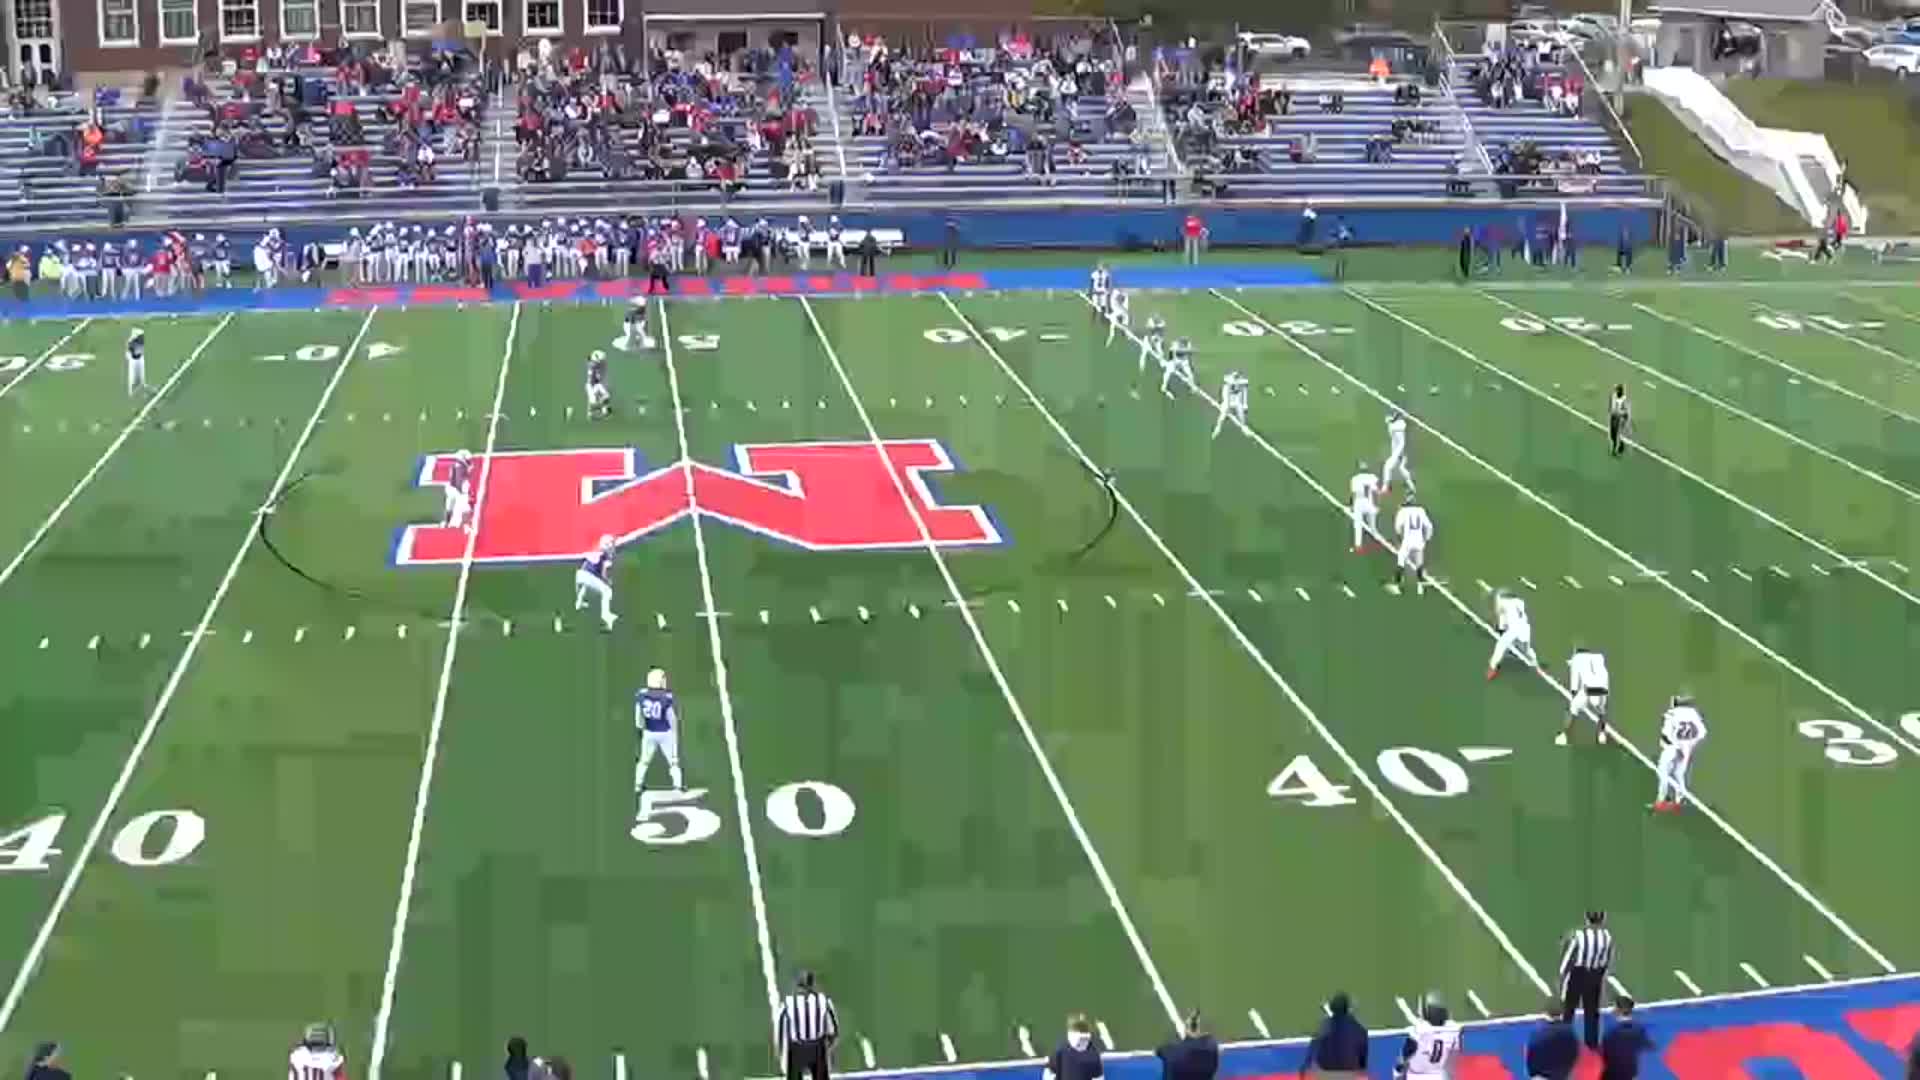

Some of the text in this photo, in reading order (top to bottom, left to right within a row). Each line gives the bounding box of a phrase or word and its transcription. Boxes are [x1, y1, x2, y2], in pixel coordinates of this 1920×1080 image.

[395, 438, 1005, 567] M
[642, 700, 662, 720] 20
[1798, 712, 1920, 765] 3
[1267, 747, 1469, 807] 40
[0, 808, 205, 871] 40
[630, 780, 856, 845] 50
